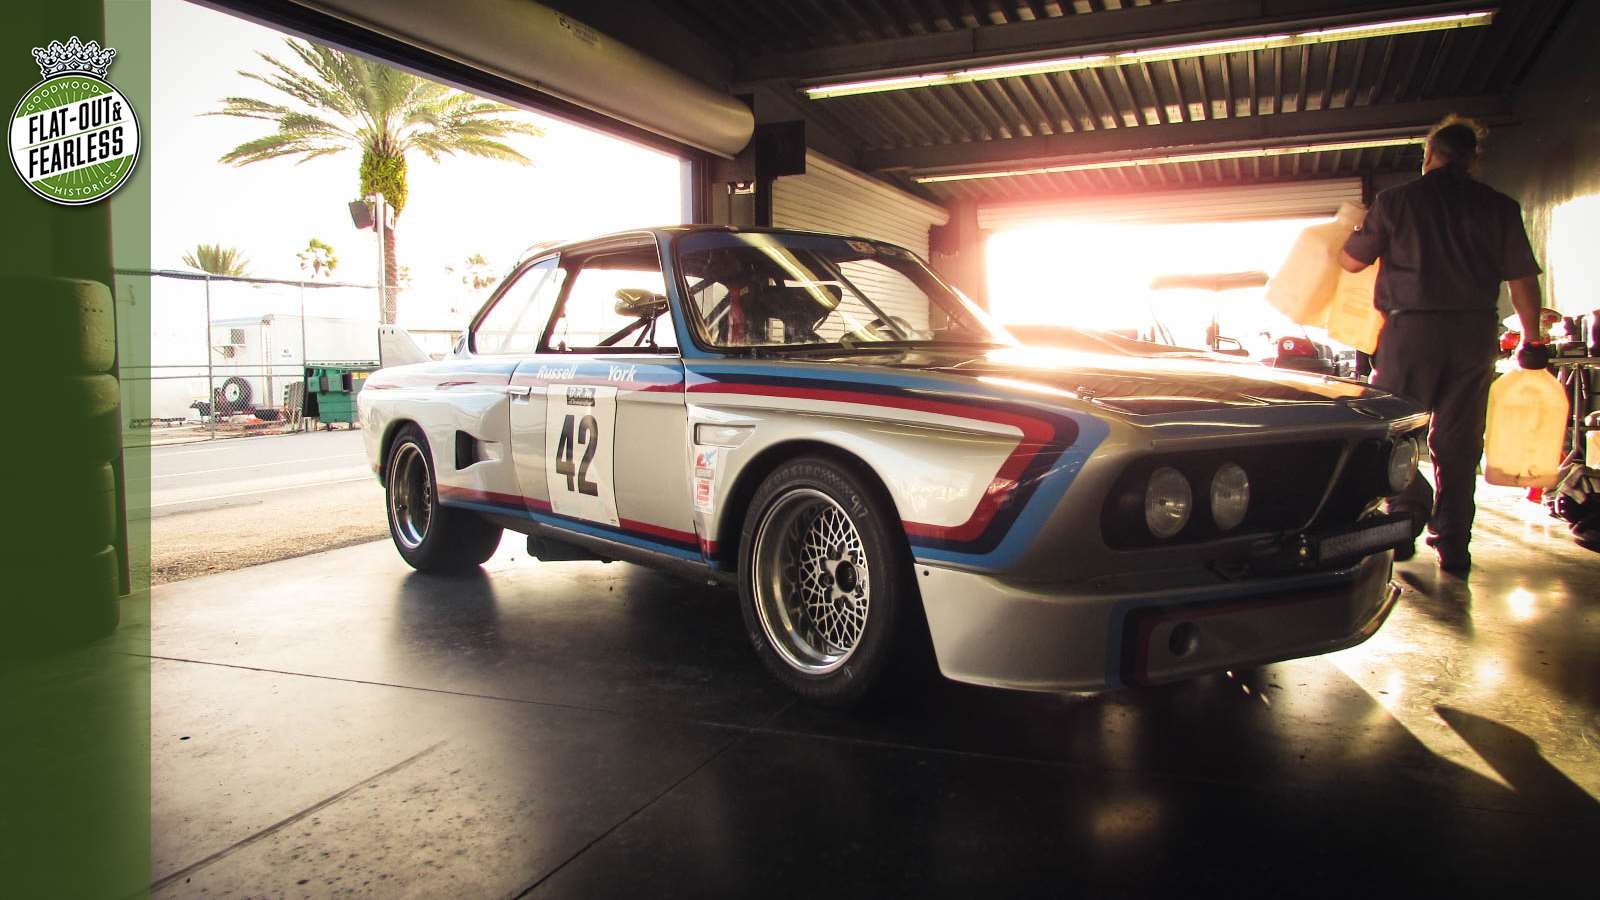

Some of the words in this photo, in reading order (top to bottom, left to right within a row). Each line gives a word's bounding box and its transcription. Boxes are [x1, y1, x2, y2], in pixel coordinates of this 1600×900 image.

[536, 364, 577, 380] Russell
[607, 365, 636, 382] York
[556, 415, 599, 497] 42
